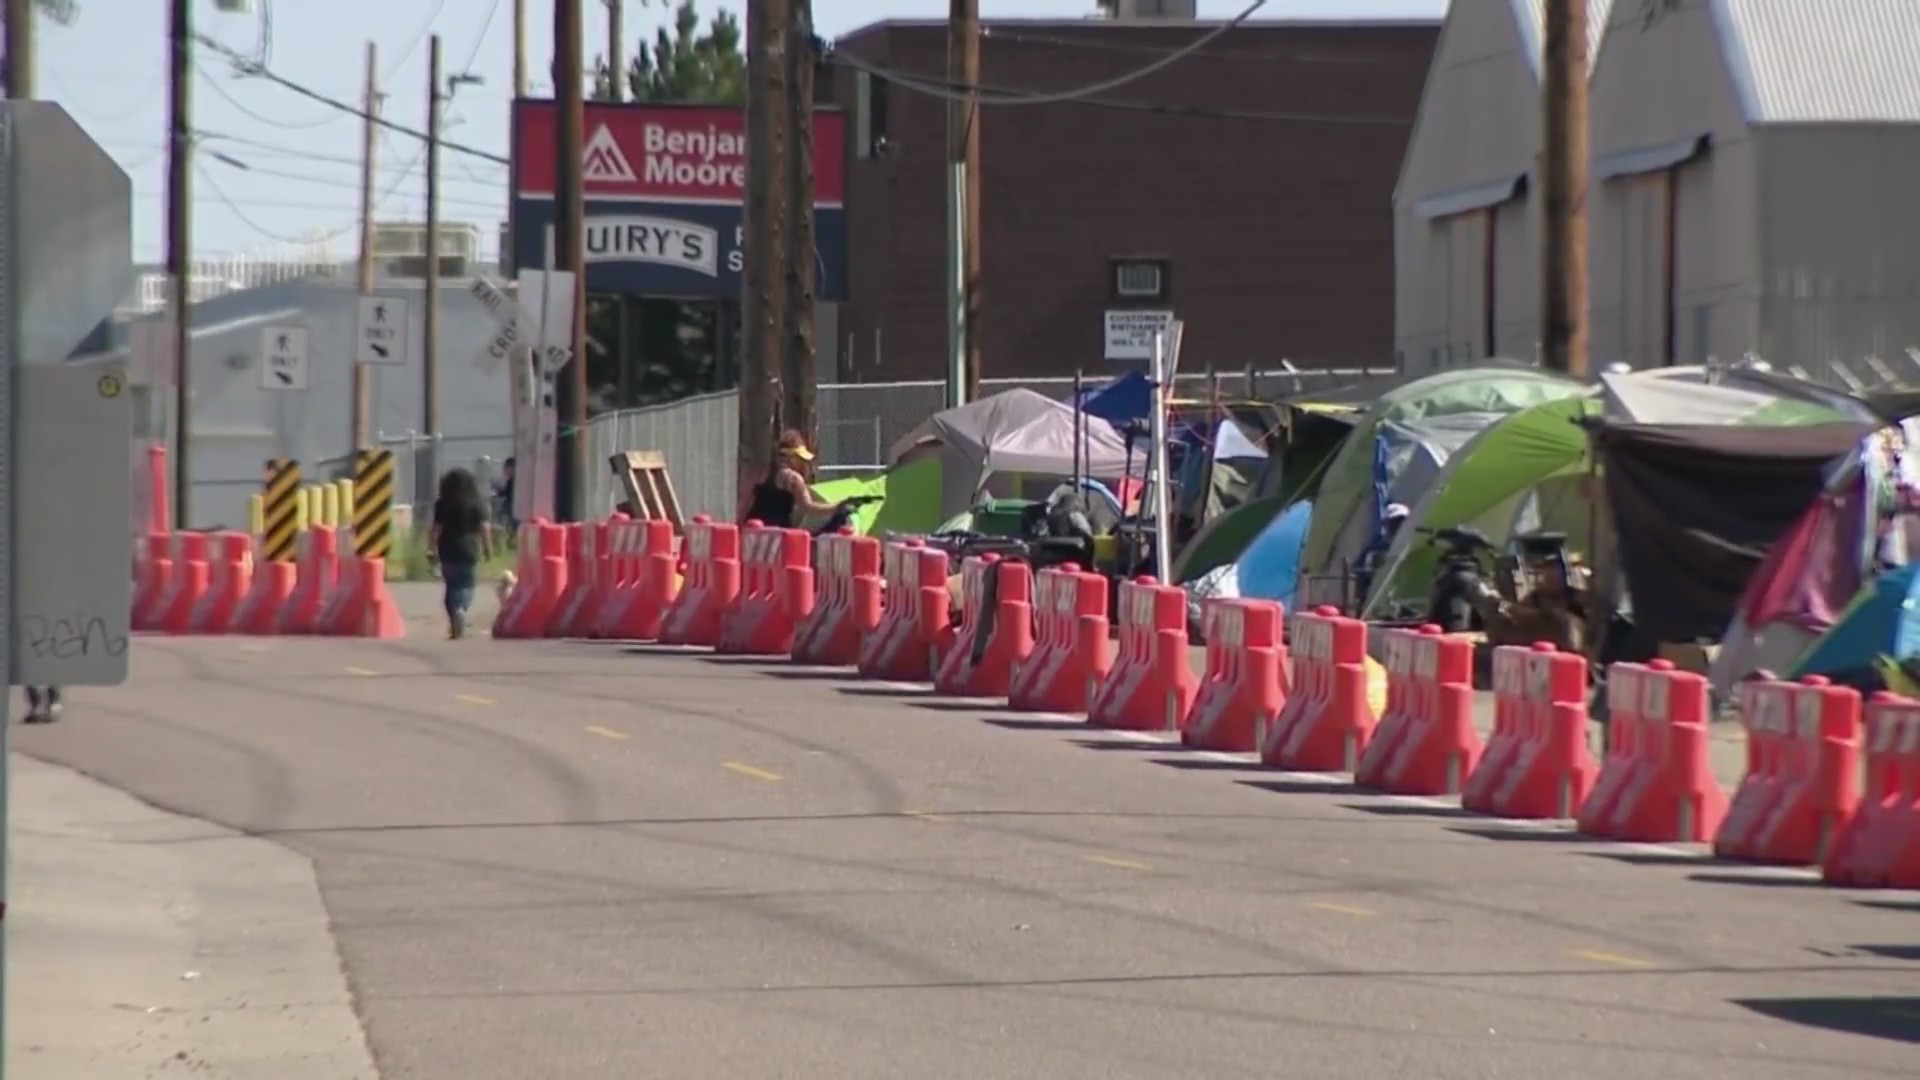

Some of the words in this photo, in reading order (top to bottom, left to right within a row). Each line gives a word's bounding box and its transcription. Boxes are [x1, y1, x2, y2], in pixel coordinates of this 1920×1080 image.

[645, 154, 745, 187] Moore
[586, 224, 704, 260] UIRY'S
[366, 327, 395, 340] ONLY
[488, 320, 517, 360] CRO
[270, 355, 299, 367] ONLY
